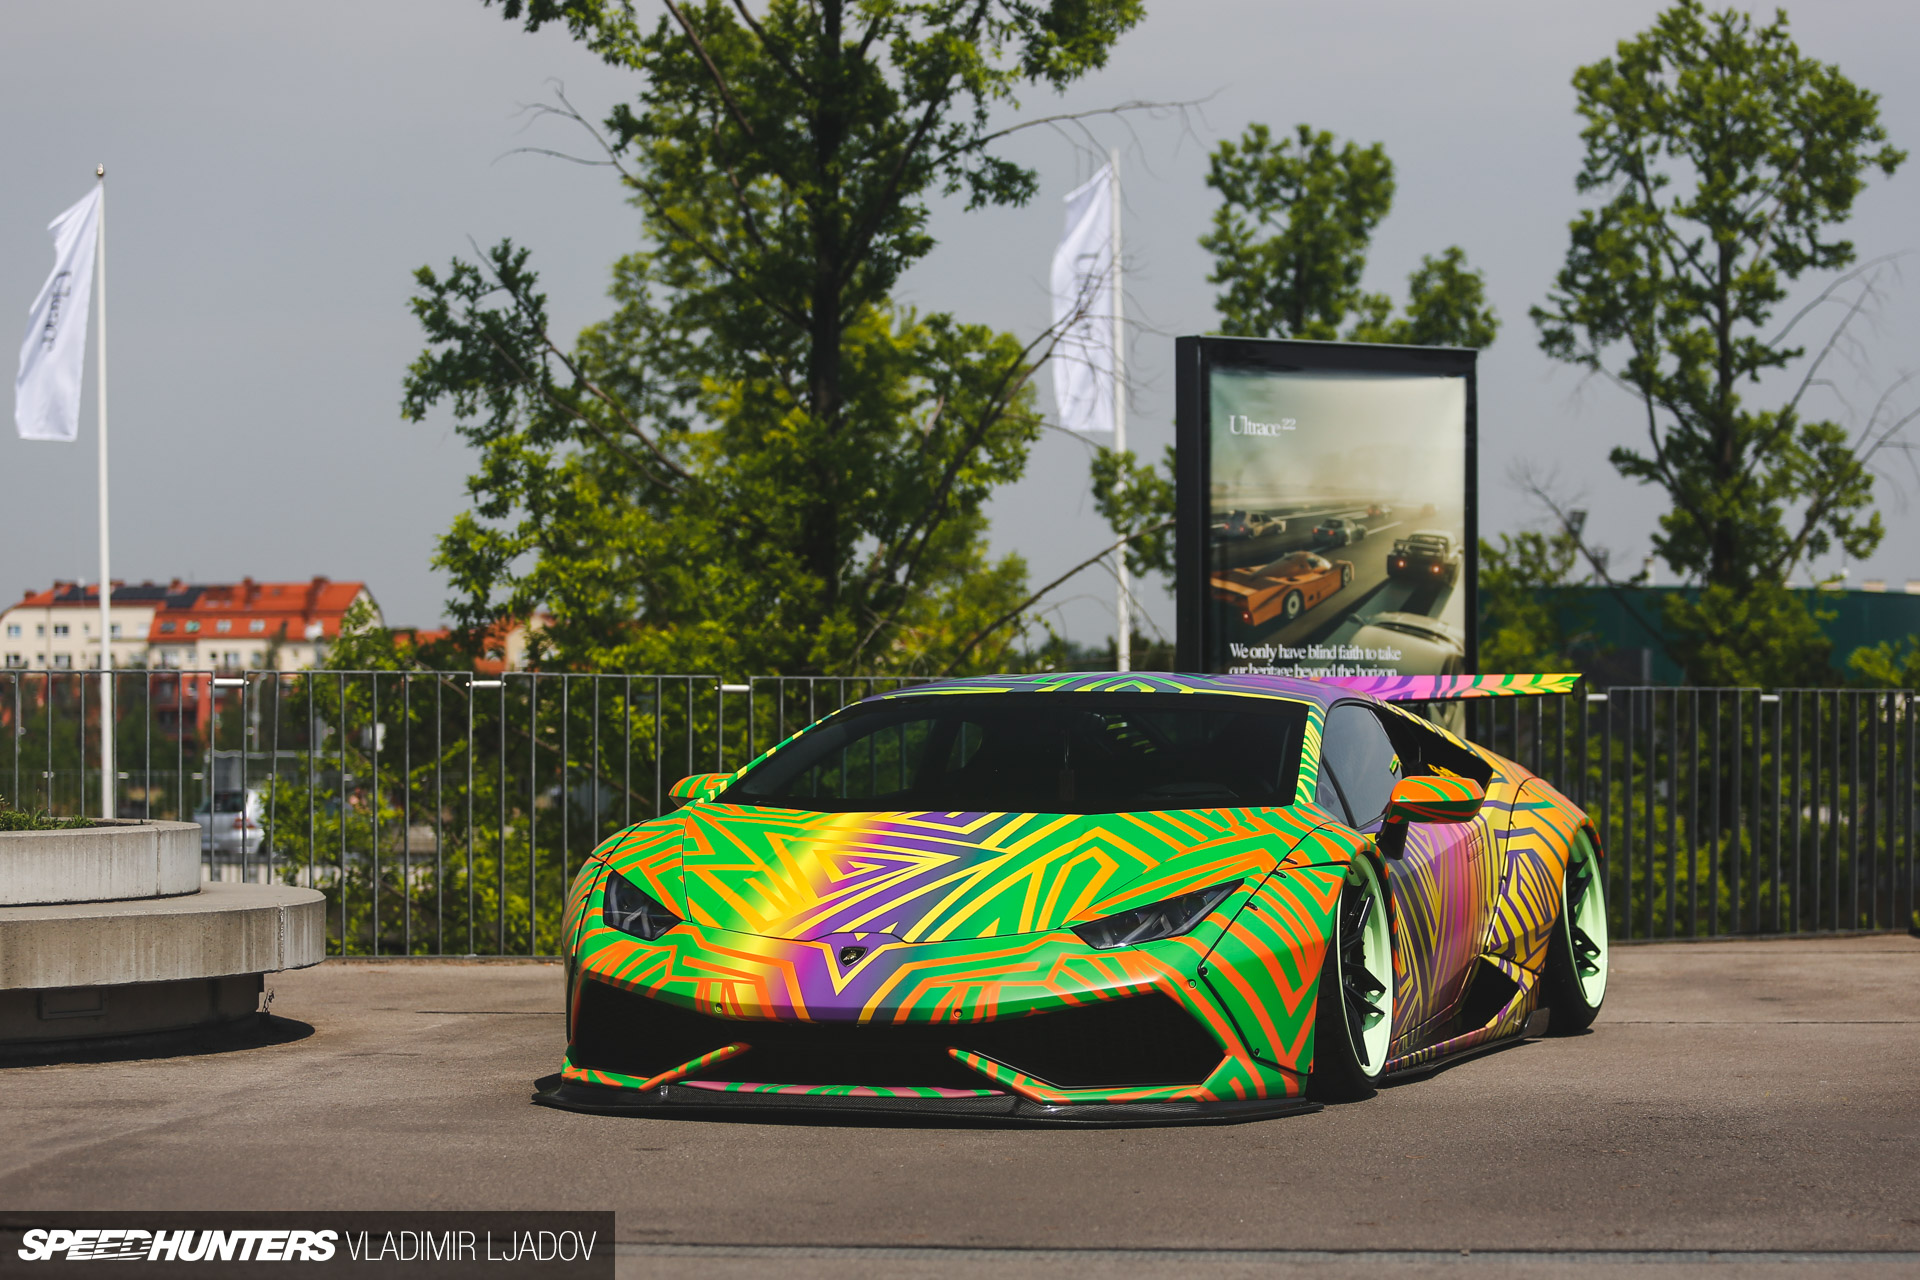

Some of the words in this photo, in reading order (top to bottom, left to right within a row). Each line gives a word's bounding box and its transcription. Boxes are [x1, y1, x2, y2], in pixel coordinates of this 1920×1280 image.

[1229, 642, 1248, 659] We
[1249, 642, 1278, 662] only
[1278, 643, 1306, 659] have
[1307, 643, 1336, 660] blind
[1337, 644, 1364, 661] faith
[1365, 647, 1377, 661] to
[1378, 645, 1402, 661] take
[1337, 664, 1356, 678] the
